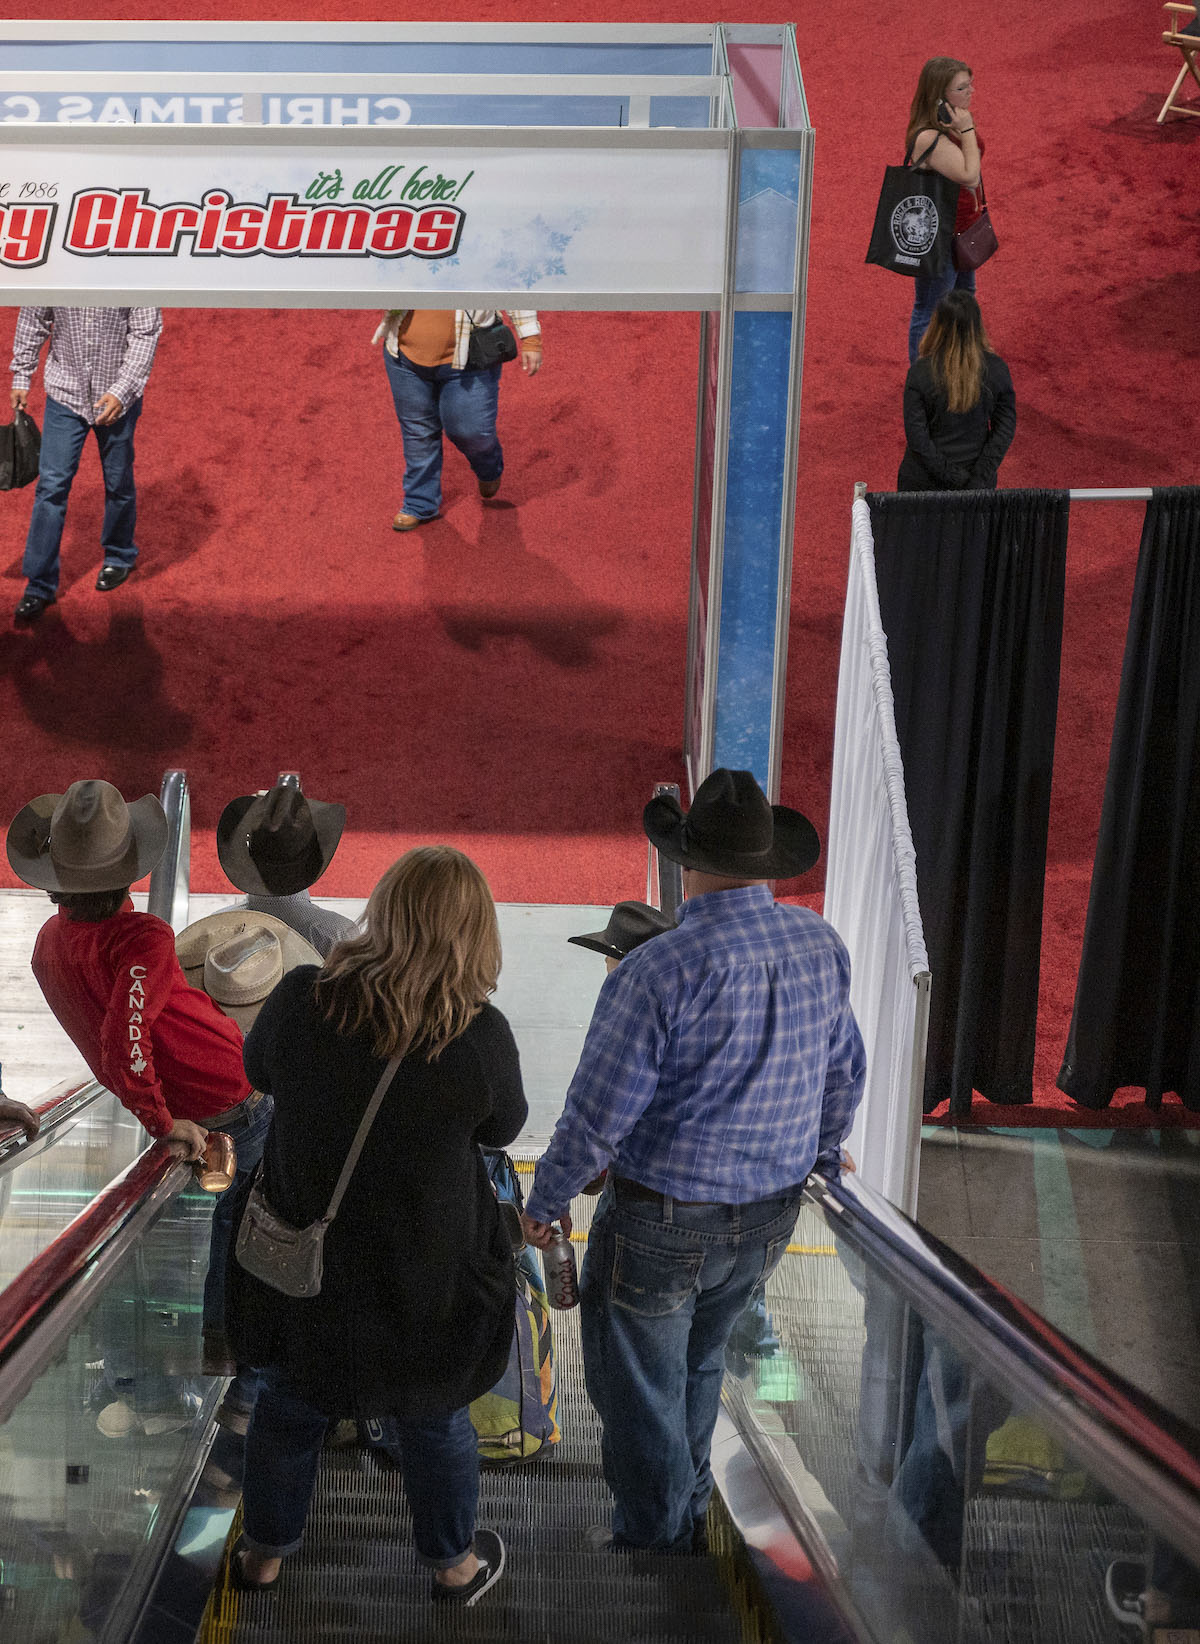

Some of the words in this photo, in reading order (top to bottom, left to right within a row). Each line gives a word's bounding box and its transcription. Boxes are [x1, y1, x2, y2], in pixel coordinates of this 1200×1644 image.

[18, 181, 59, 199] 1986
[305, 168, 344, 199] it's
[352, 165, 405, 200] all
[400, 165, 475, 201] here!
[65, 189, 463, 257] Christmas
[129, 965, 147, 1058] CANADA
